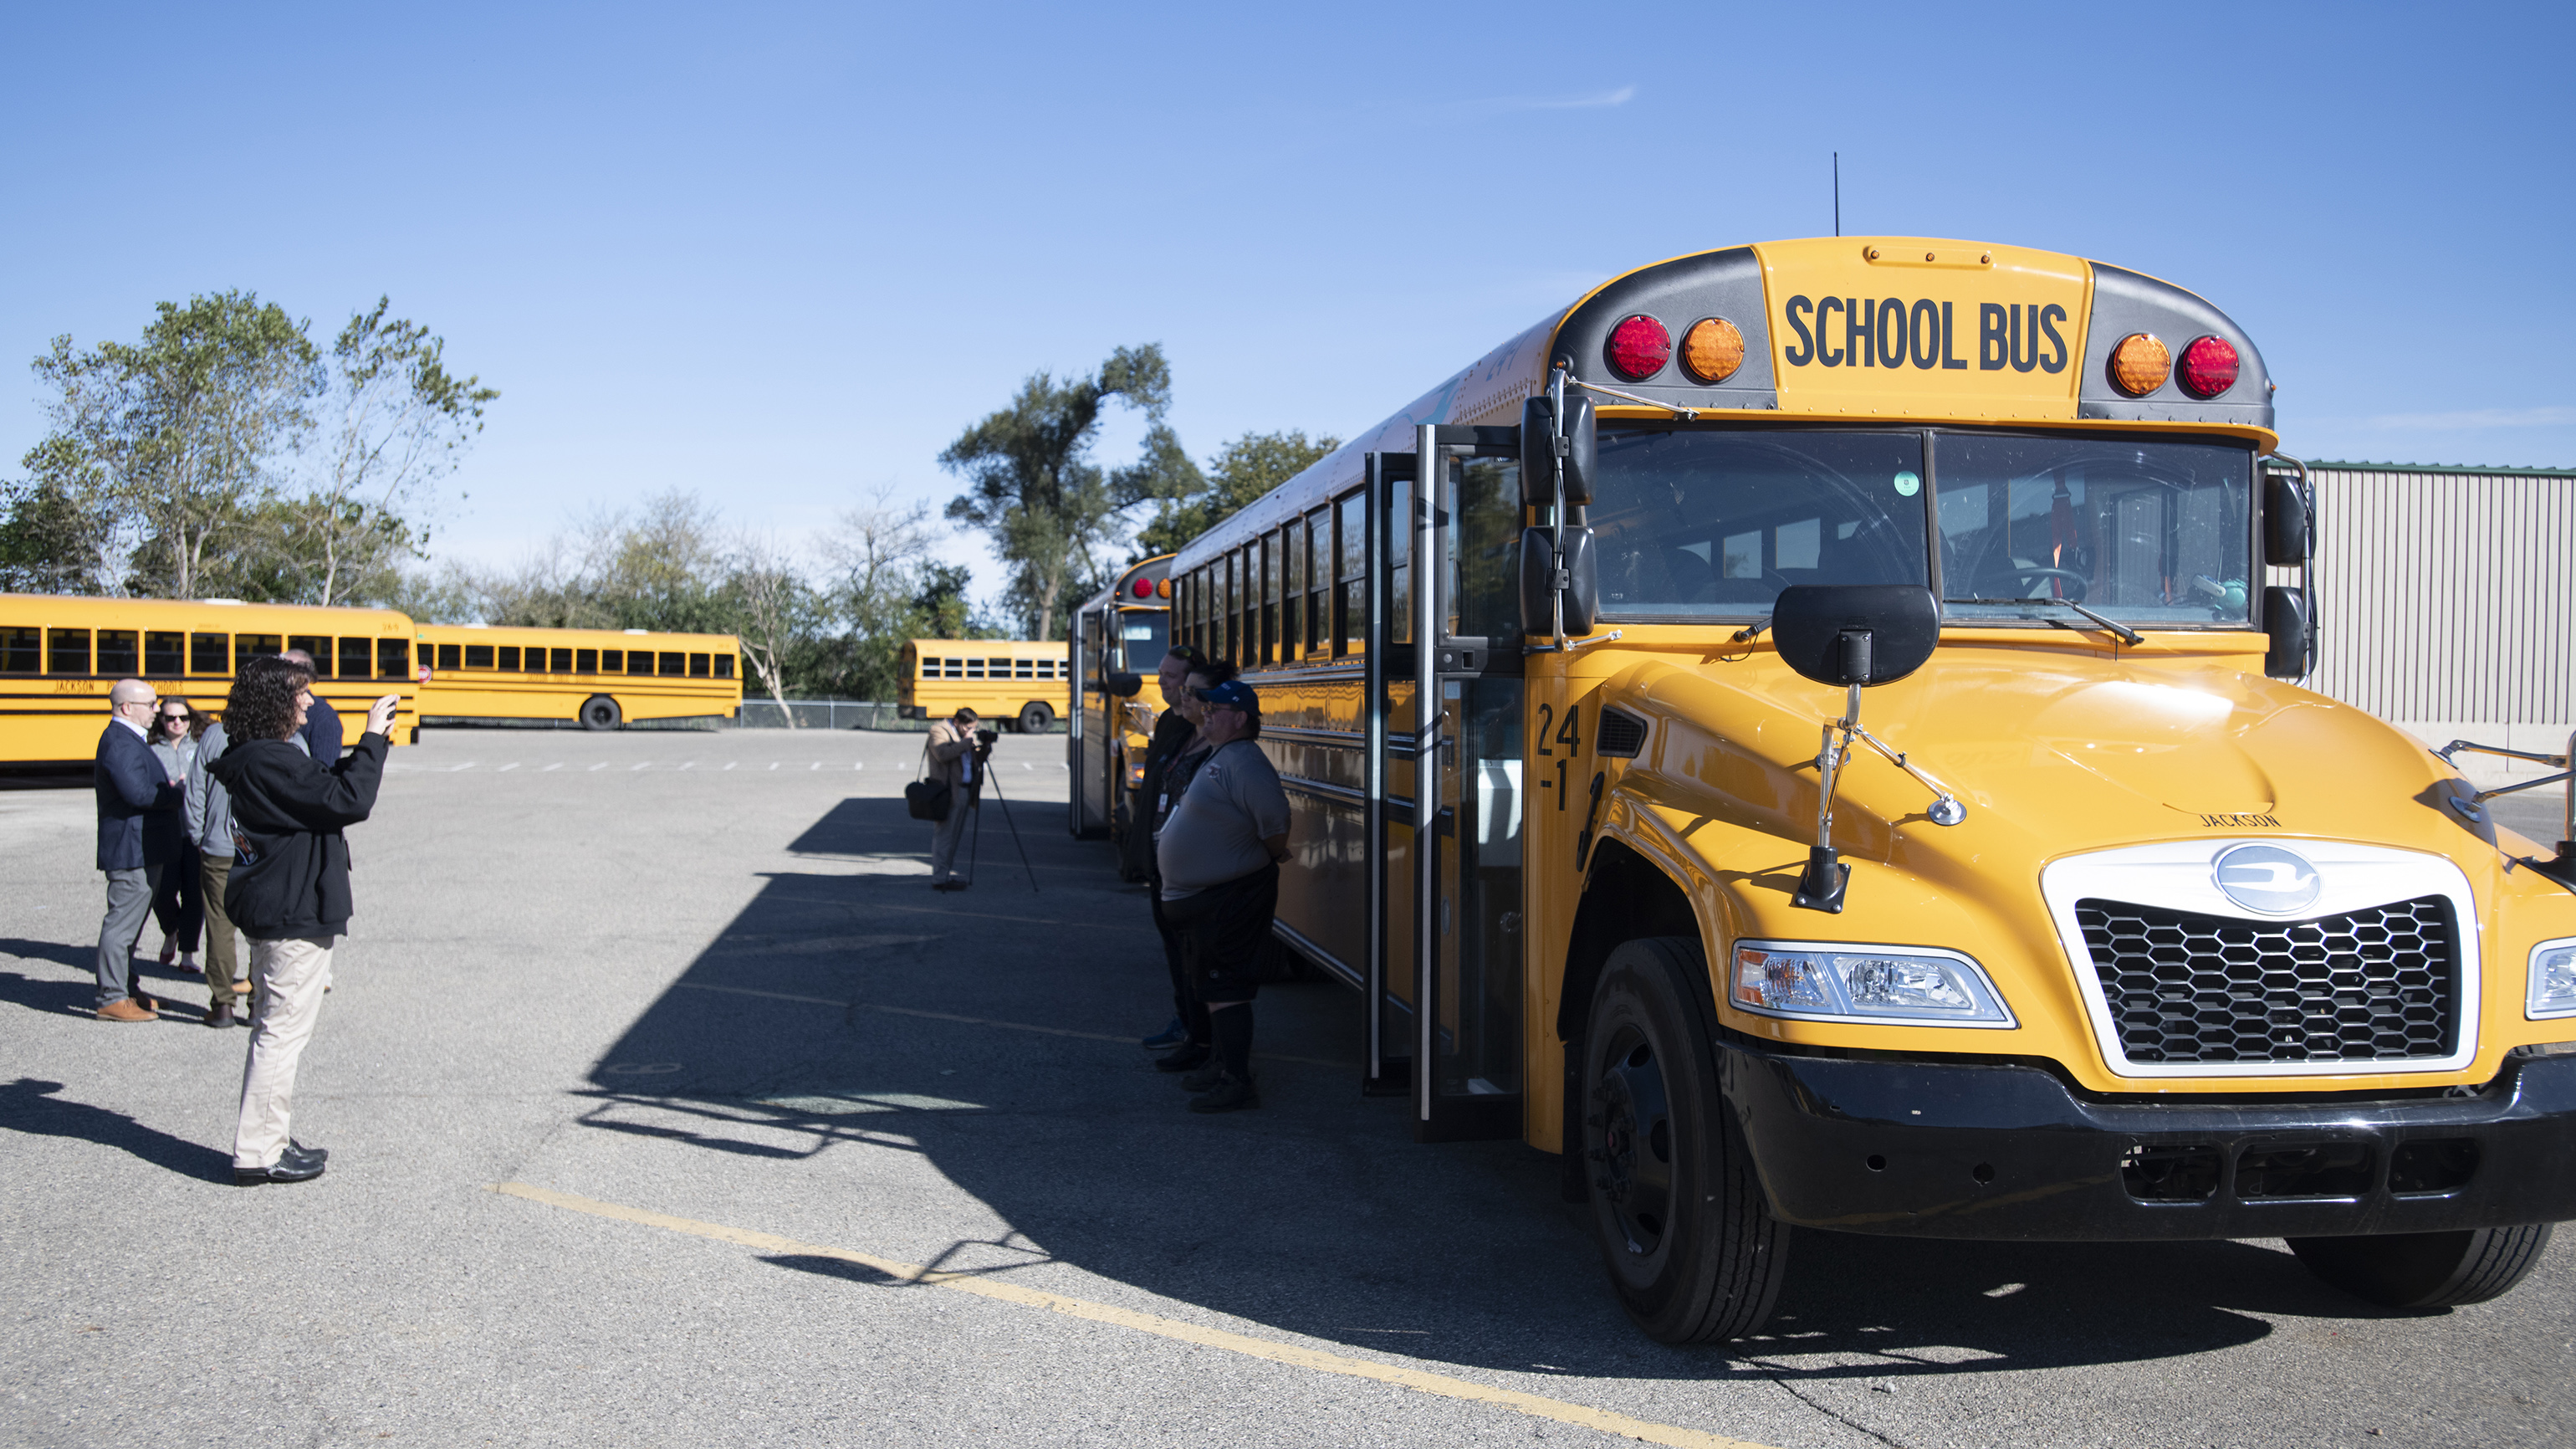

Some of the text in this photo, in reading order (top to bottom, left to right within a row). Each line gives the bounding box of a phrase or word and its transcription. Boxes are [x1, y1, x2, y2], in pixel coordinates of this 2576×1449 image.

[1785, 294, 2067, 374] SCHOOL BUS
[54, 680, 94, 694] JACKSON
[1538, 703, 1580, 757] 24
[1541, 759, 1567, 811] -1
[2200, 815, 2282, 827] JACKSON
